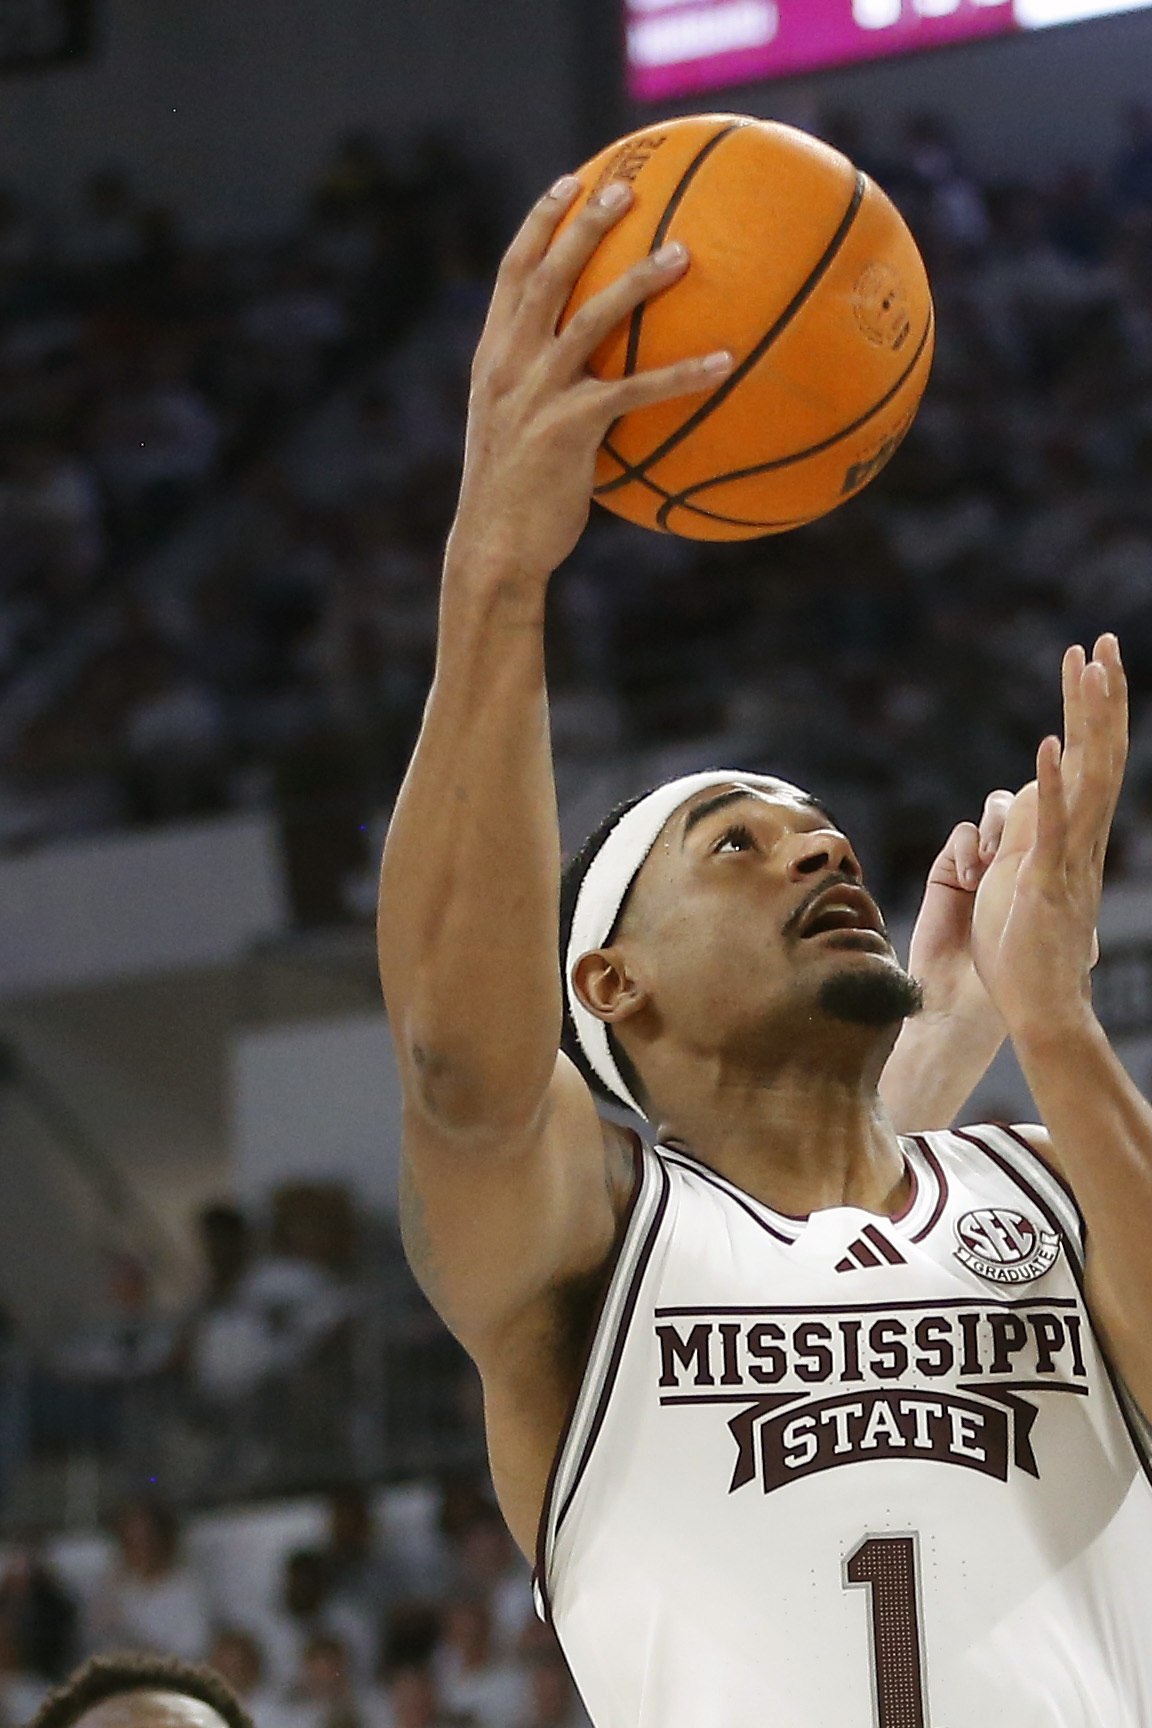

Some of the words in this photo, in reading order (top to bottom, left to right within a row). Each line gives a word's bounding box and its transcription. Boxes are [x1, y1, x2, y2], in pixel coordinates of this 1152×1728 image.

[959, 1209, 1034, 1263] SEC
[973, 1250, 1054, 1281] GRADUATE
[656, 1313, 1086, 1388] MISSISSIPPI
[781, 1400, 988, 1468] STATE
